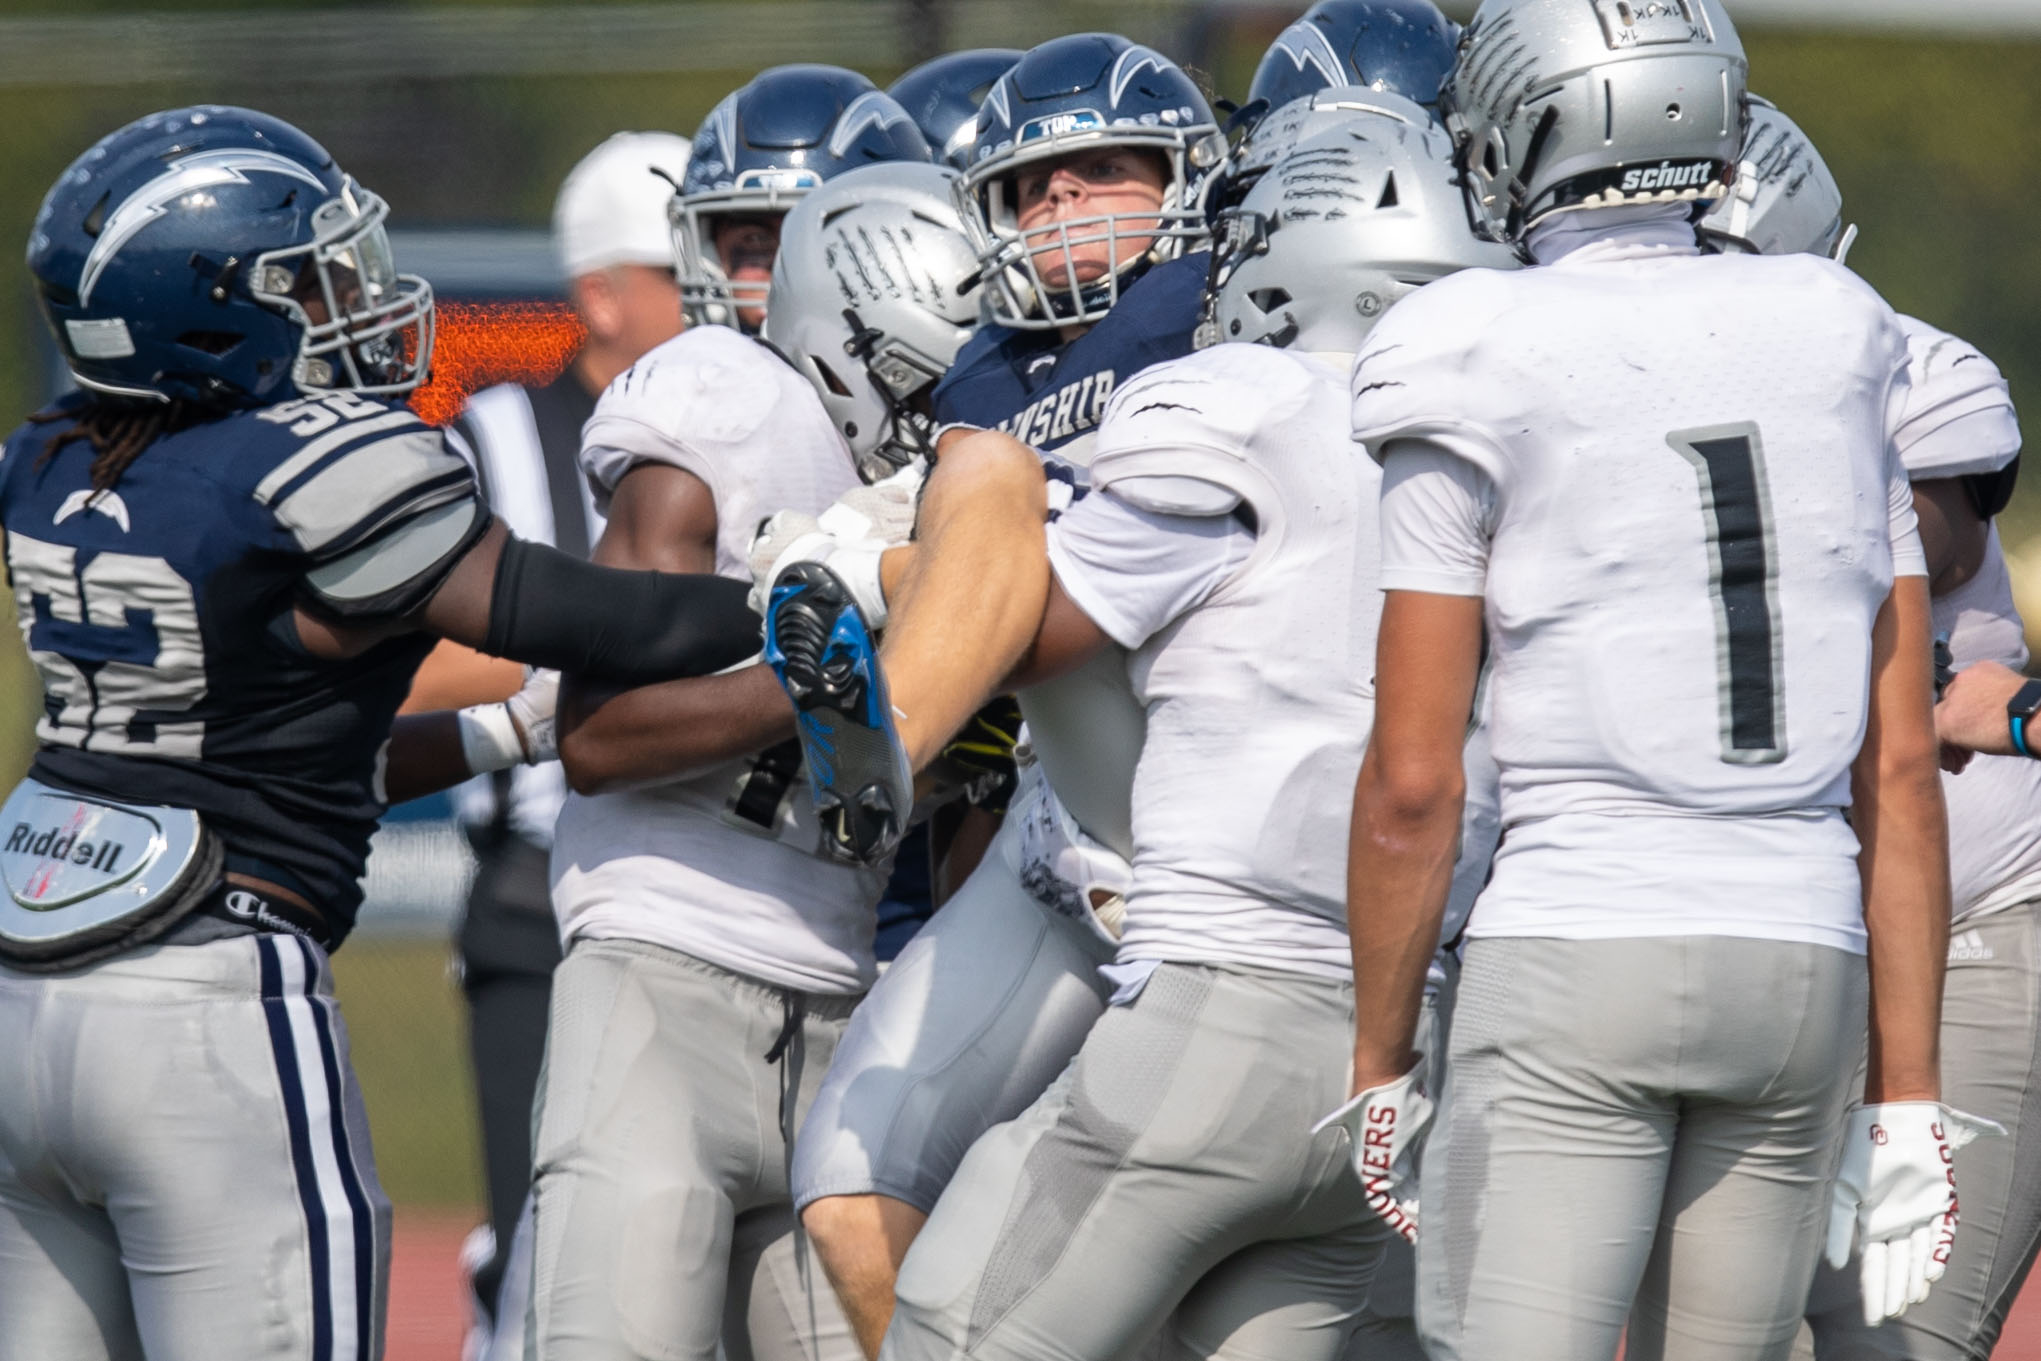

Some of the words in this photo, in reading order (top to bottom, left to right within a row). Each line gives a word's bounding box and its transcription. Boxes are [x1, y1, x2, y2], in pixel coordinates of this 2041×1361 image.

[1620, 160, 1712, 190] schutt
[256, 391, 389, 437] 52
[996, 368, 1115, 446] NSHIP
[1666, 420, 1788, 764] 1
[8, 530, 208, 759] 52
[4, 822, 124, 873] Riddell
